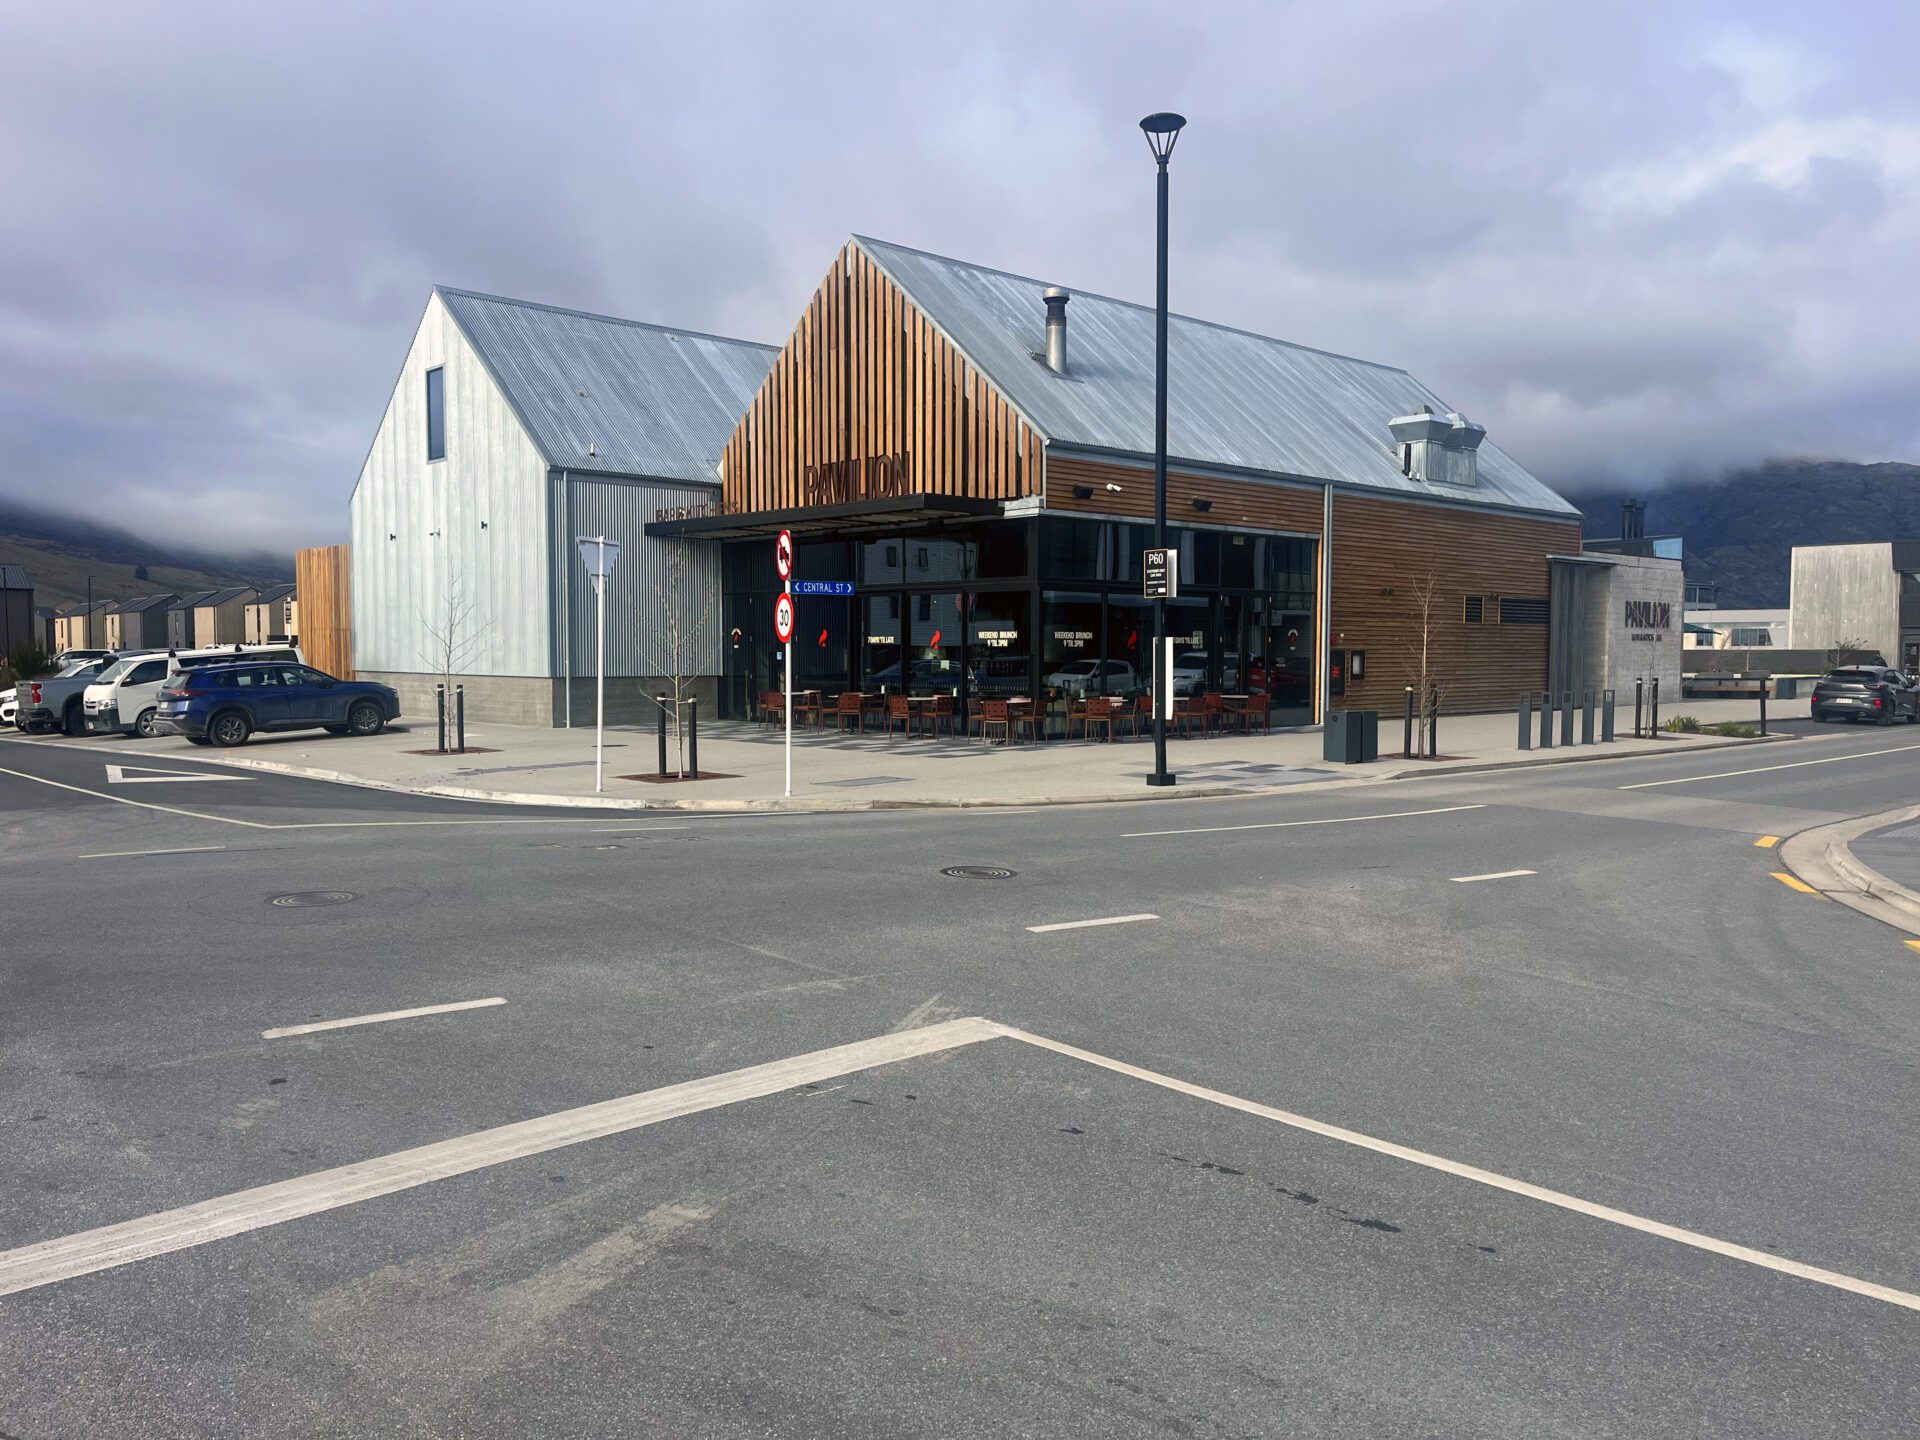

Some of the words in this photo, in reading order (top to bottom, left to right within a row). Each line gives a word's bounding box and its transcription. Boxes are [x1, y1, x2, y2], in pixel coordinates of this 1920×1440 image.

[804, 451, 910, 507] PAVILION
[1148, 553, 1164, 565] P60
[803, 582, 833, 593] CENTRAL
[836, 583, 844, 592] ST
[779, 609, 789, 627] 30
[1625, 601, 1670, 628] PAVILION
